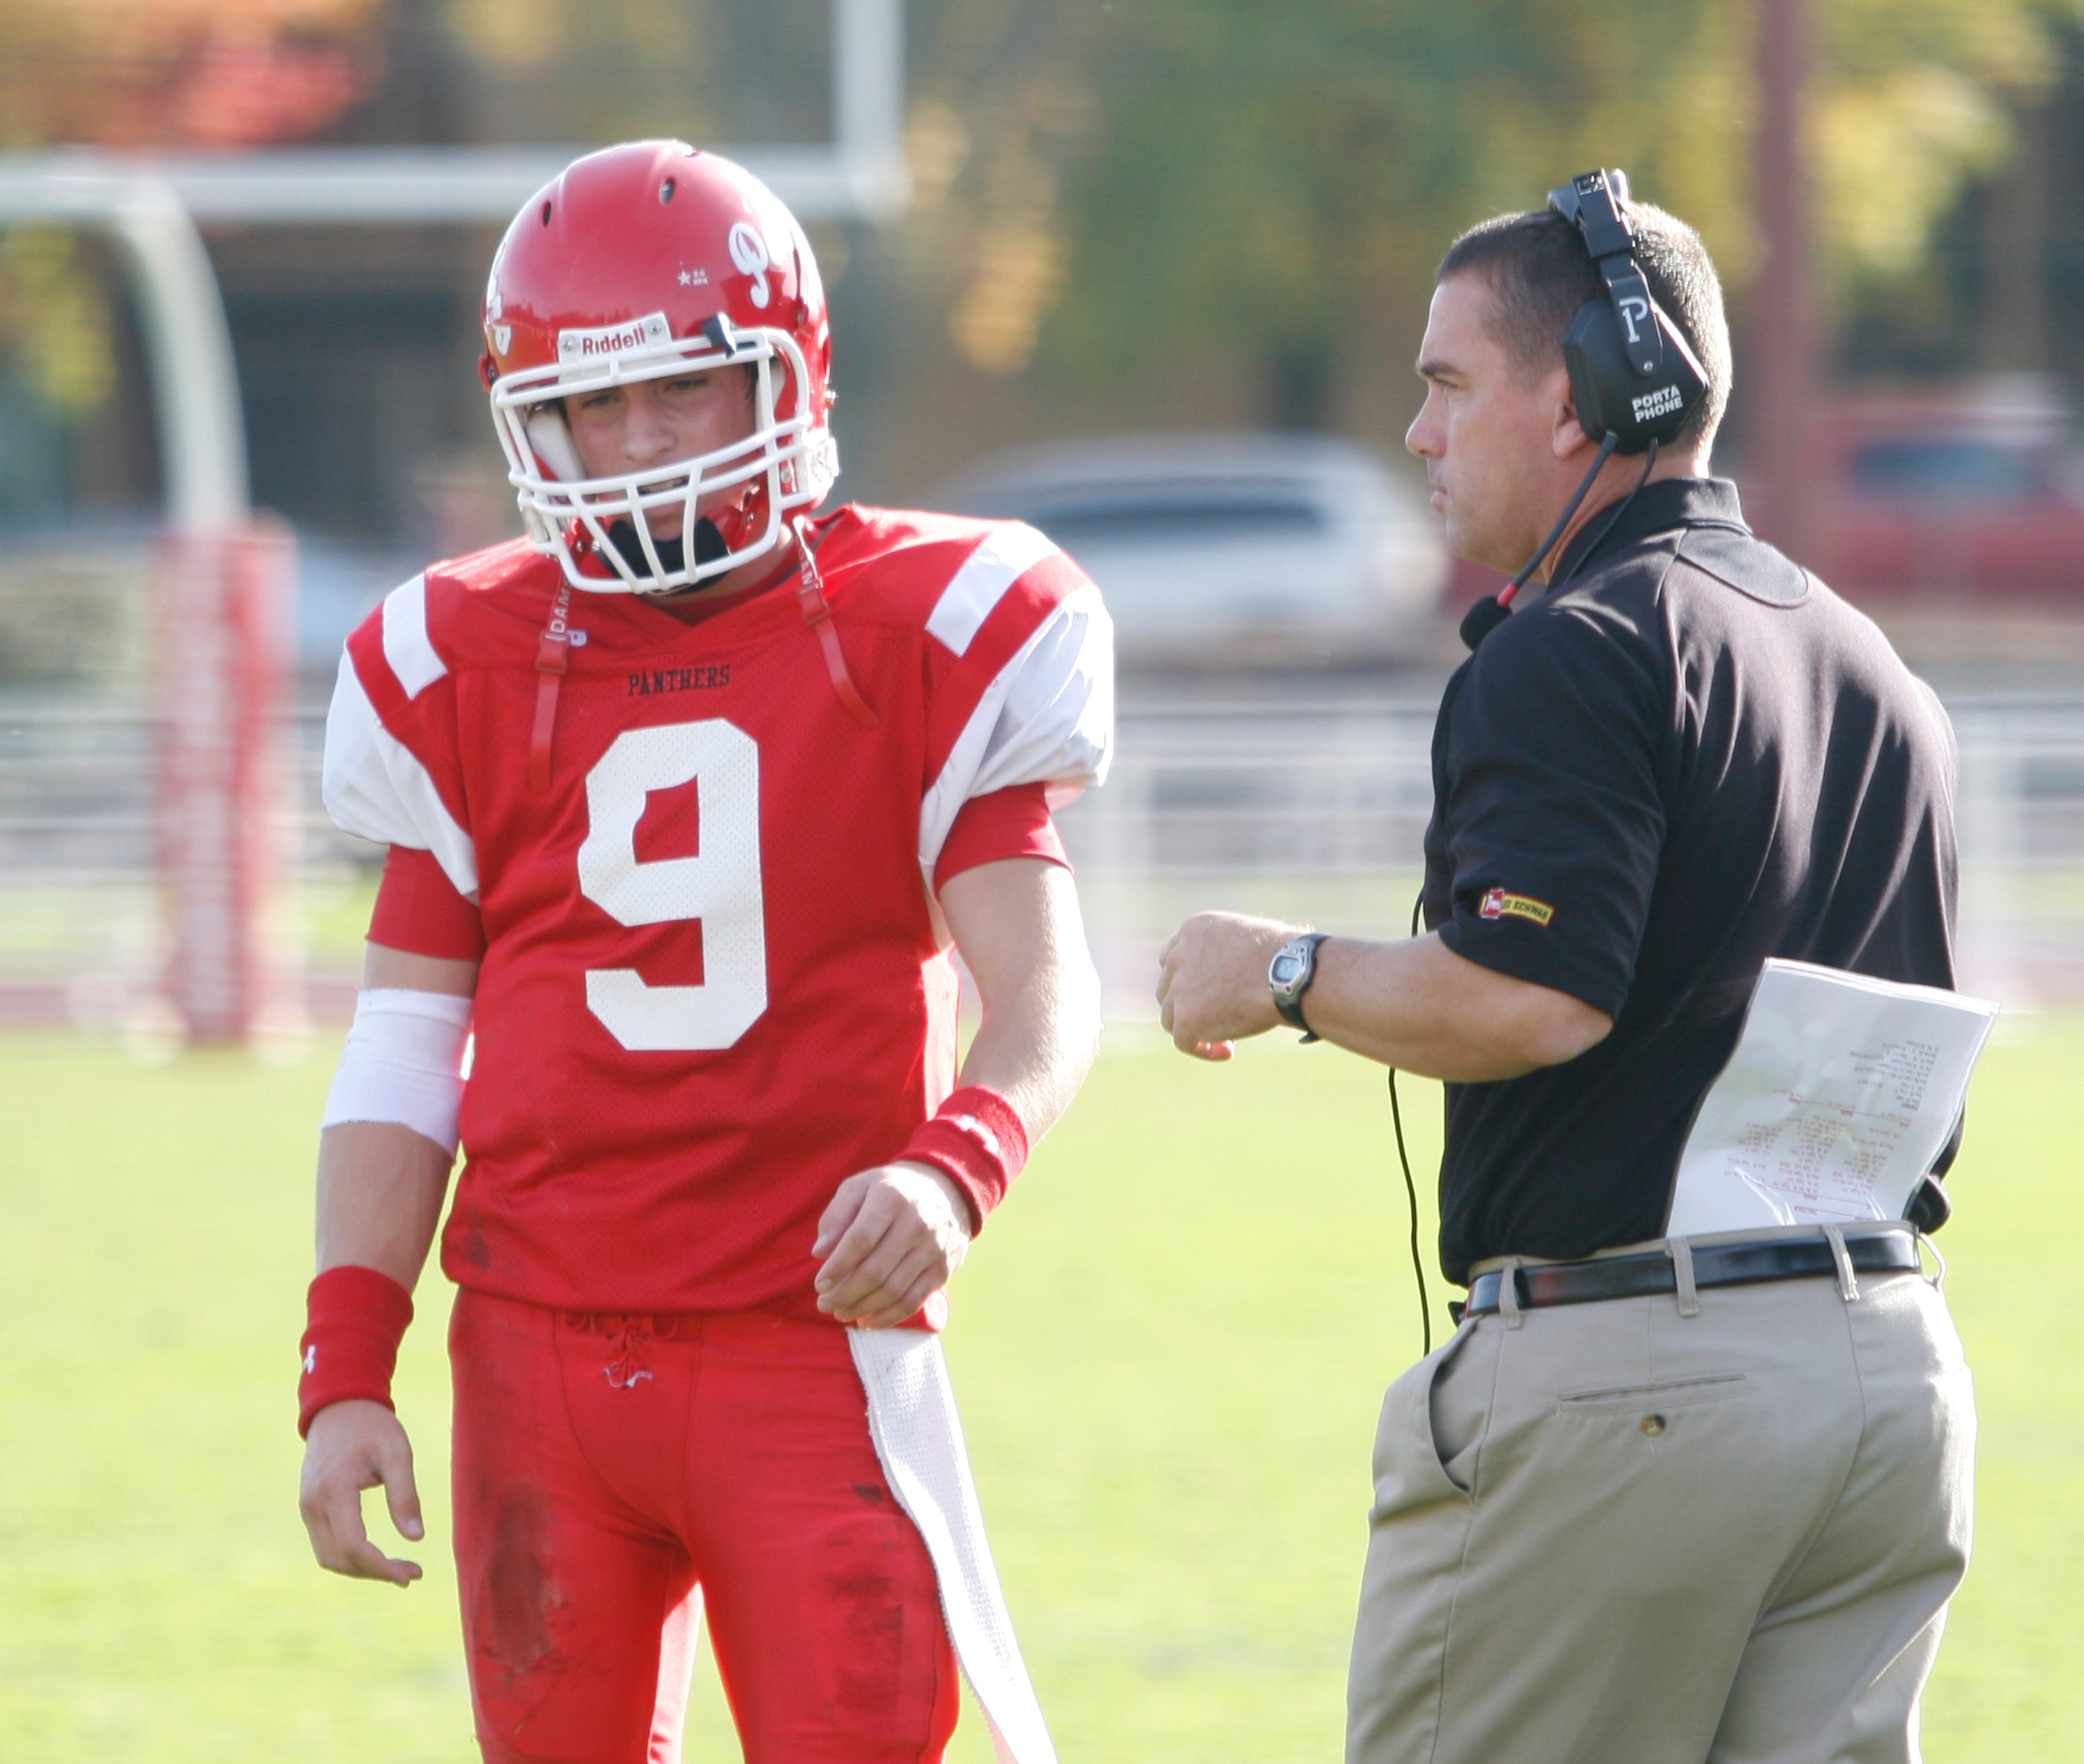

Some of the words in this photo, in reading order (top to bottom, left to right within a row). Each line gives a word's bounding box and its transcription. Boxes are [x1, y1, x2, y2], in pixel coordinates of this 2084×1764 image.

[582, 326, 646, 355] Riddell
[1632, 385, 1680, 412] PORTA
[1635, 397, 1683, 423] PHONE
[628, 665, 731, 697] PANTHERS
[577, 717, 768, 1051] 9
